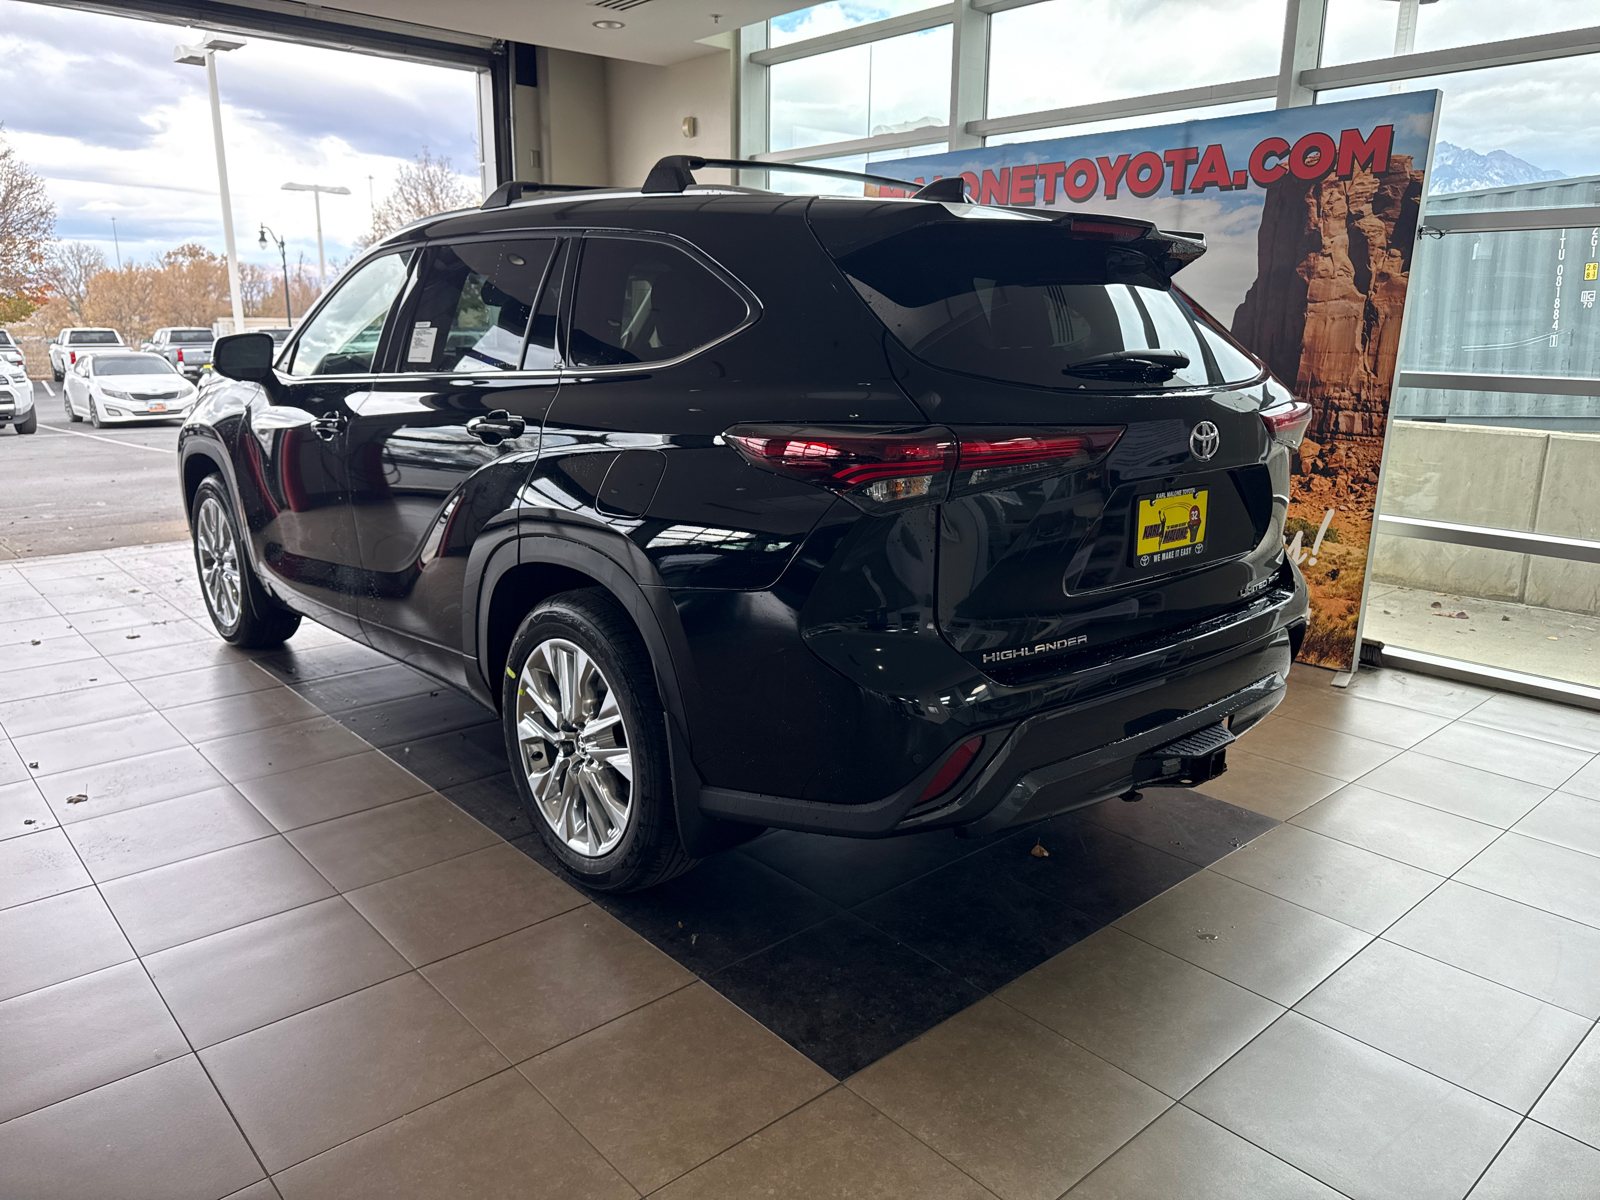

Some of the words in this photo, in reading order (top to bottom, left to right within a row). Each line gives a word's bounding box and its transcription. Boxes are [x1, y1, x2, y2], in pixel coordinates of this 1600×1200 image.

[879, 124, 1393, 206] MAONETOYOTA.COM
[1191, 510, 1199, 520] 32
[1142, 524, 1161, 540] KARL
[1162, 527, 1188, 544] MALONE
[1153, 555, 1161, 563] WE
[1161, 552, 1174, 561] MAKE
[1174, 549, 1180, 558] IT
[1180, 547, 1192, 556] EASY
[983, 635, 1087, 662] HIGHLANDER
